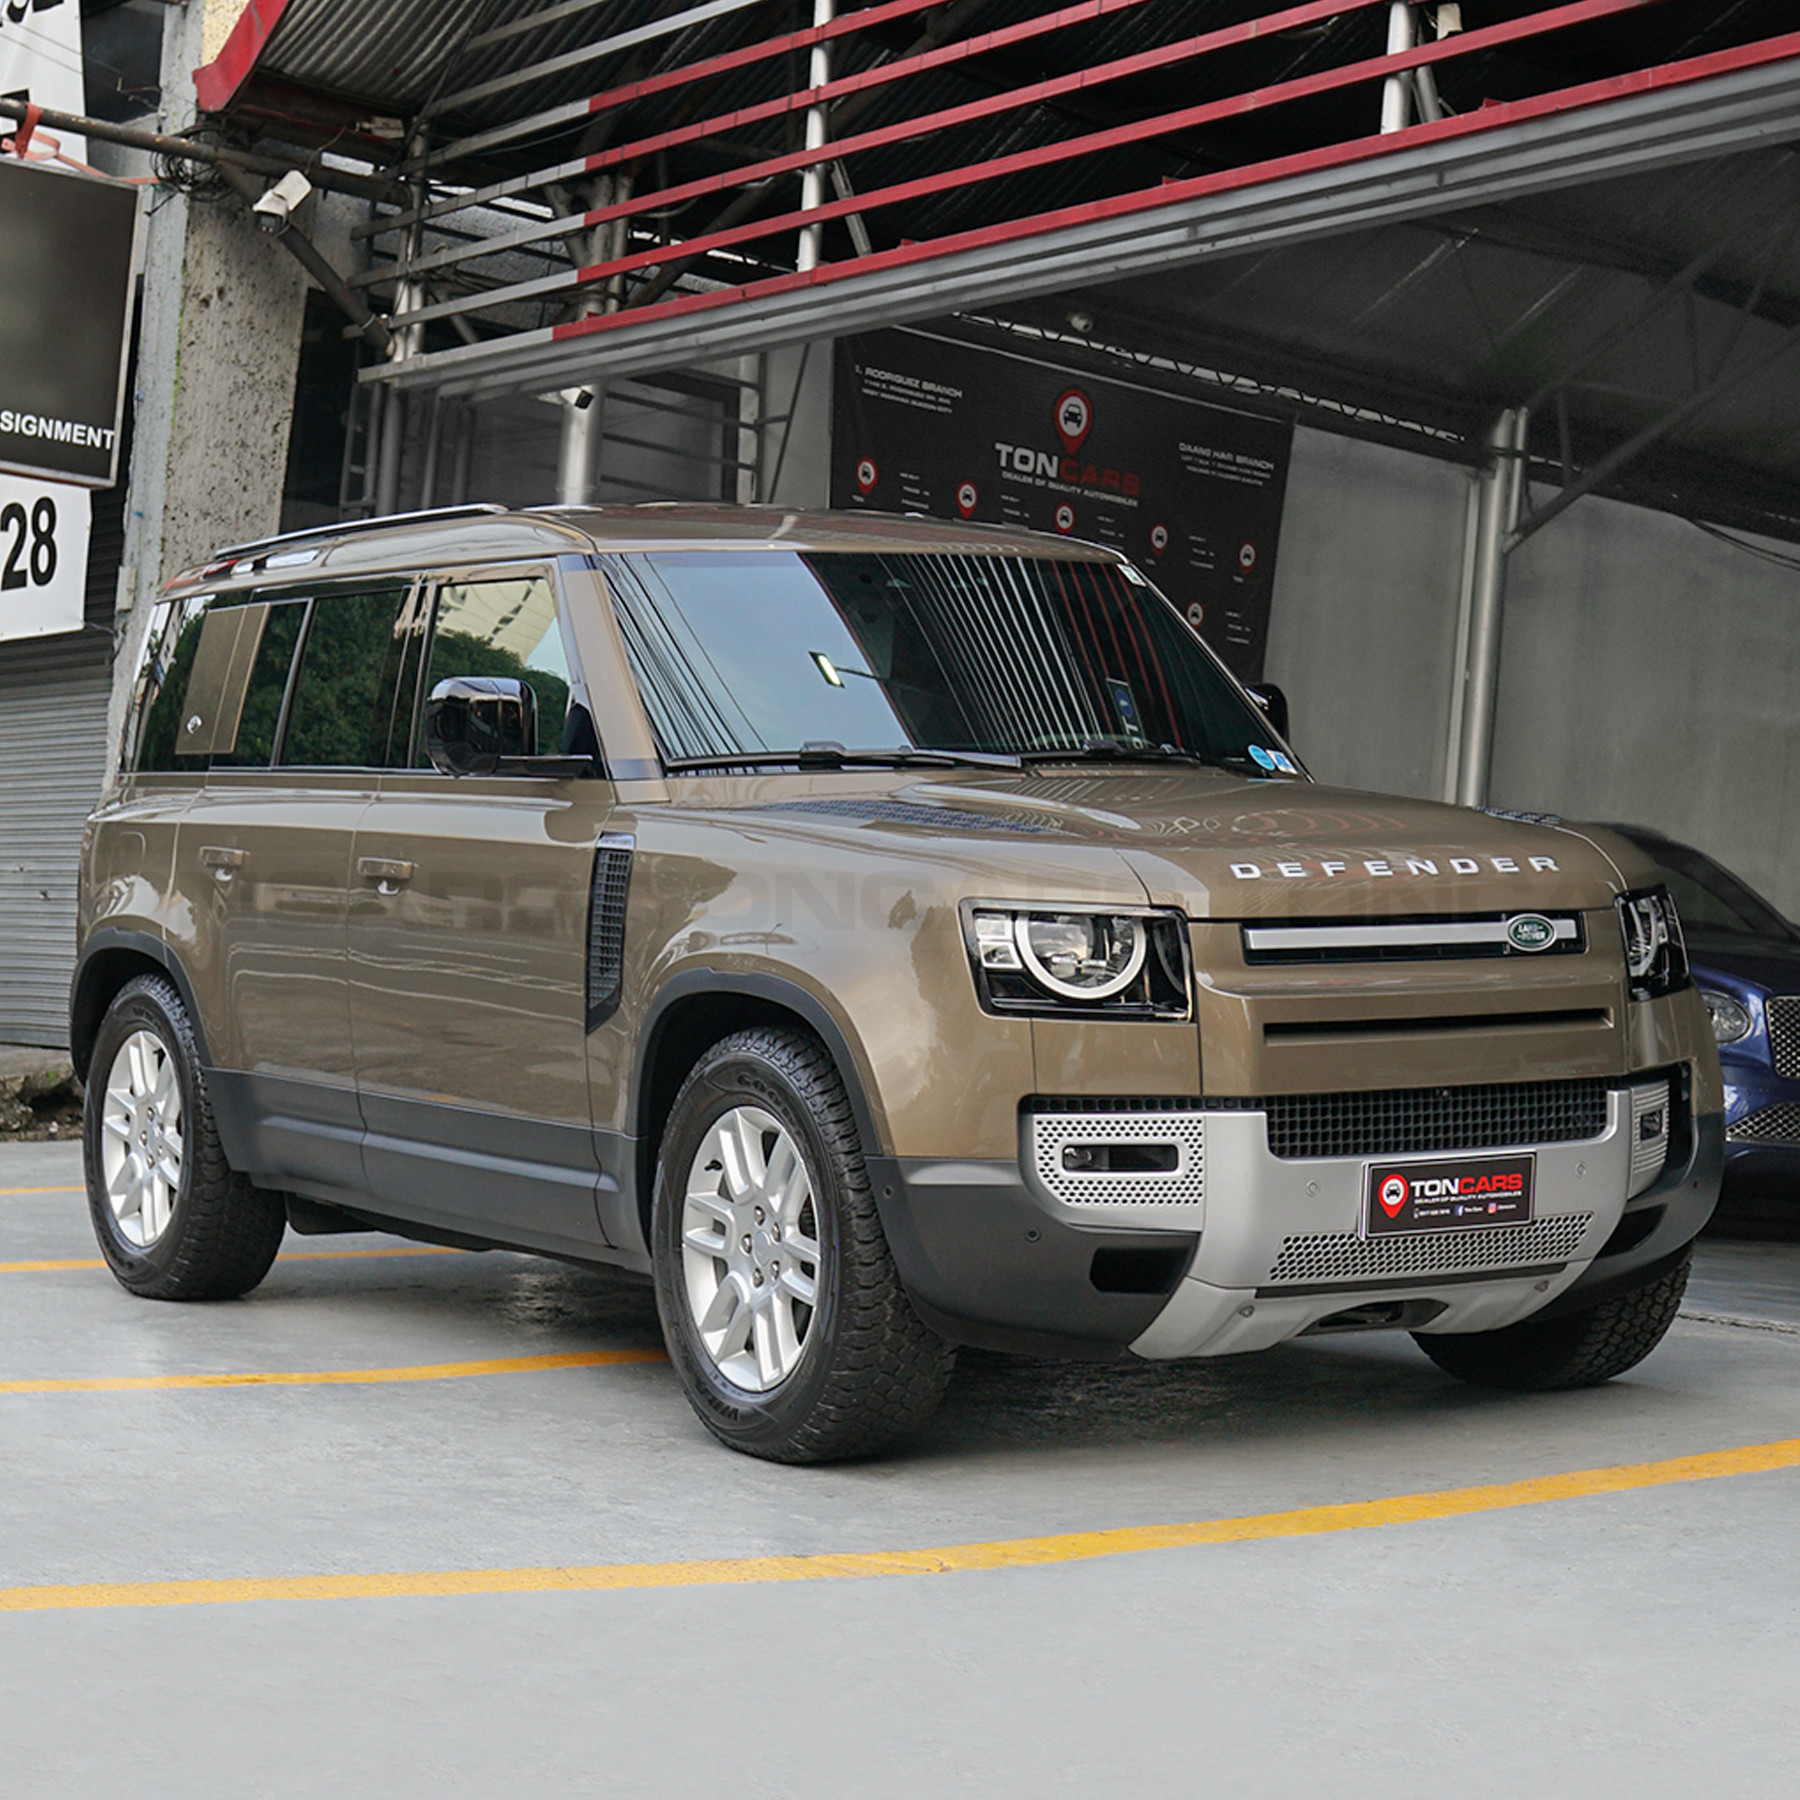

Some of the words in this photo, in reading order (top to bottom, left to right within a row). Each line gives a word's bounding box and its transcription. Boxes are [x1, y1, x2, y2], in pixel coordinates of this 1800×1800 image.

[0, 410, 114, 450] SIGNMENT
[994, 442, 1140, 496] TONCARS
[0, 496, 57, 591] 28
[1230, 856, 1560, 880] DEFENDER
[1410, 1173, 1523, 1197] TONCARS
